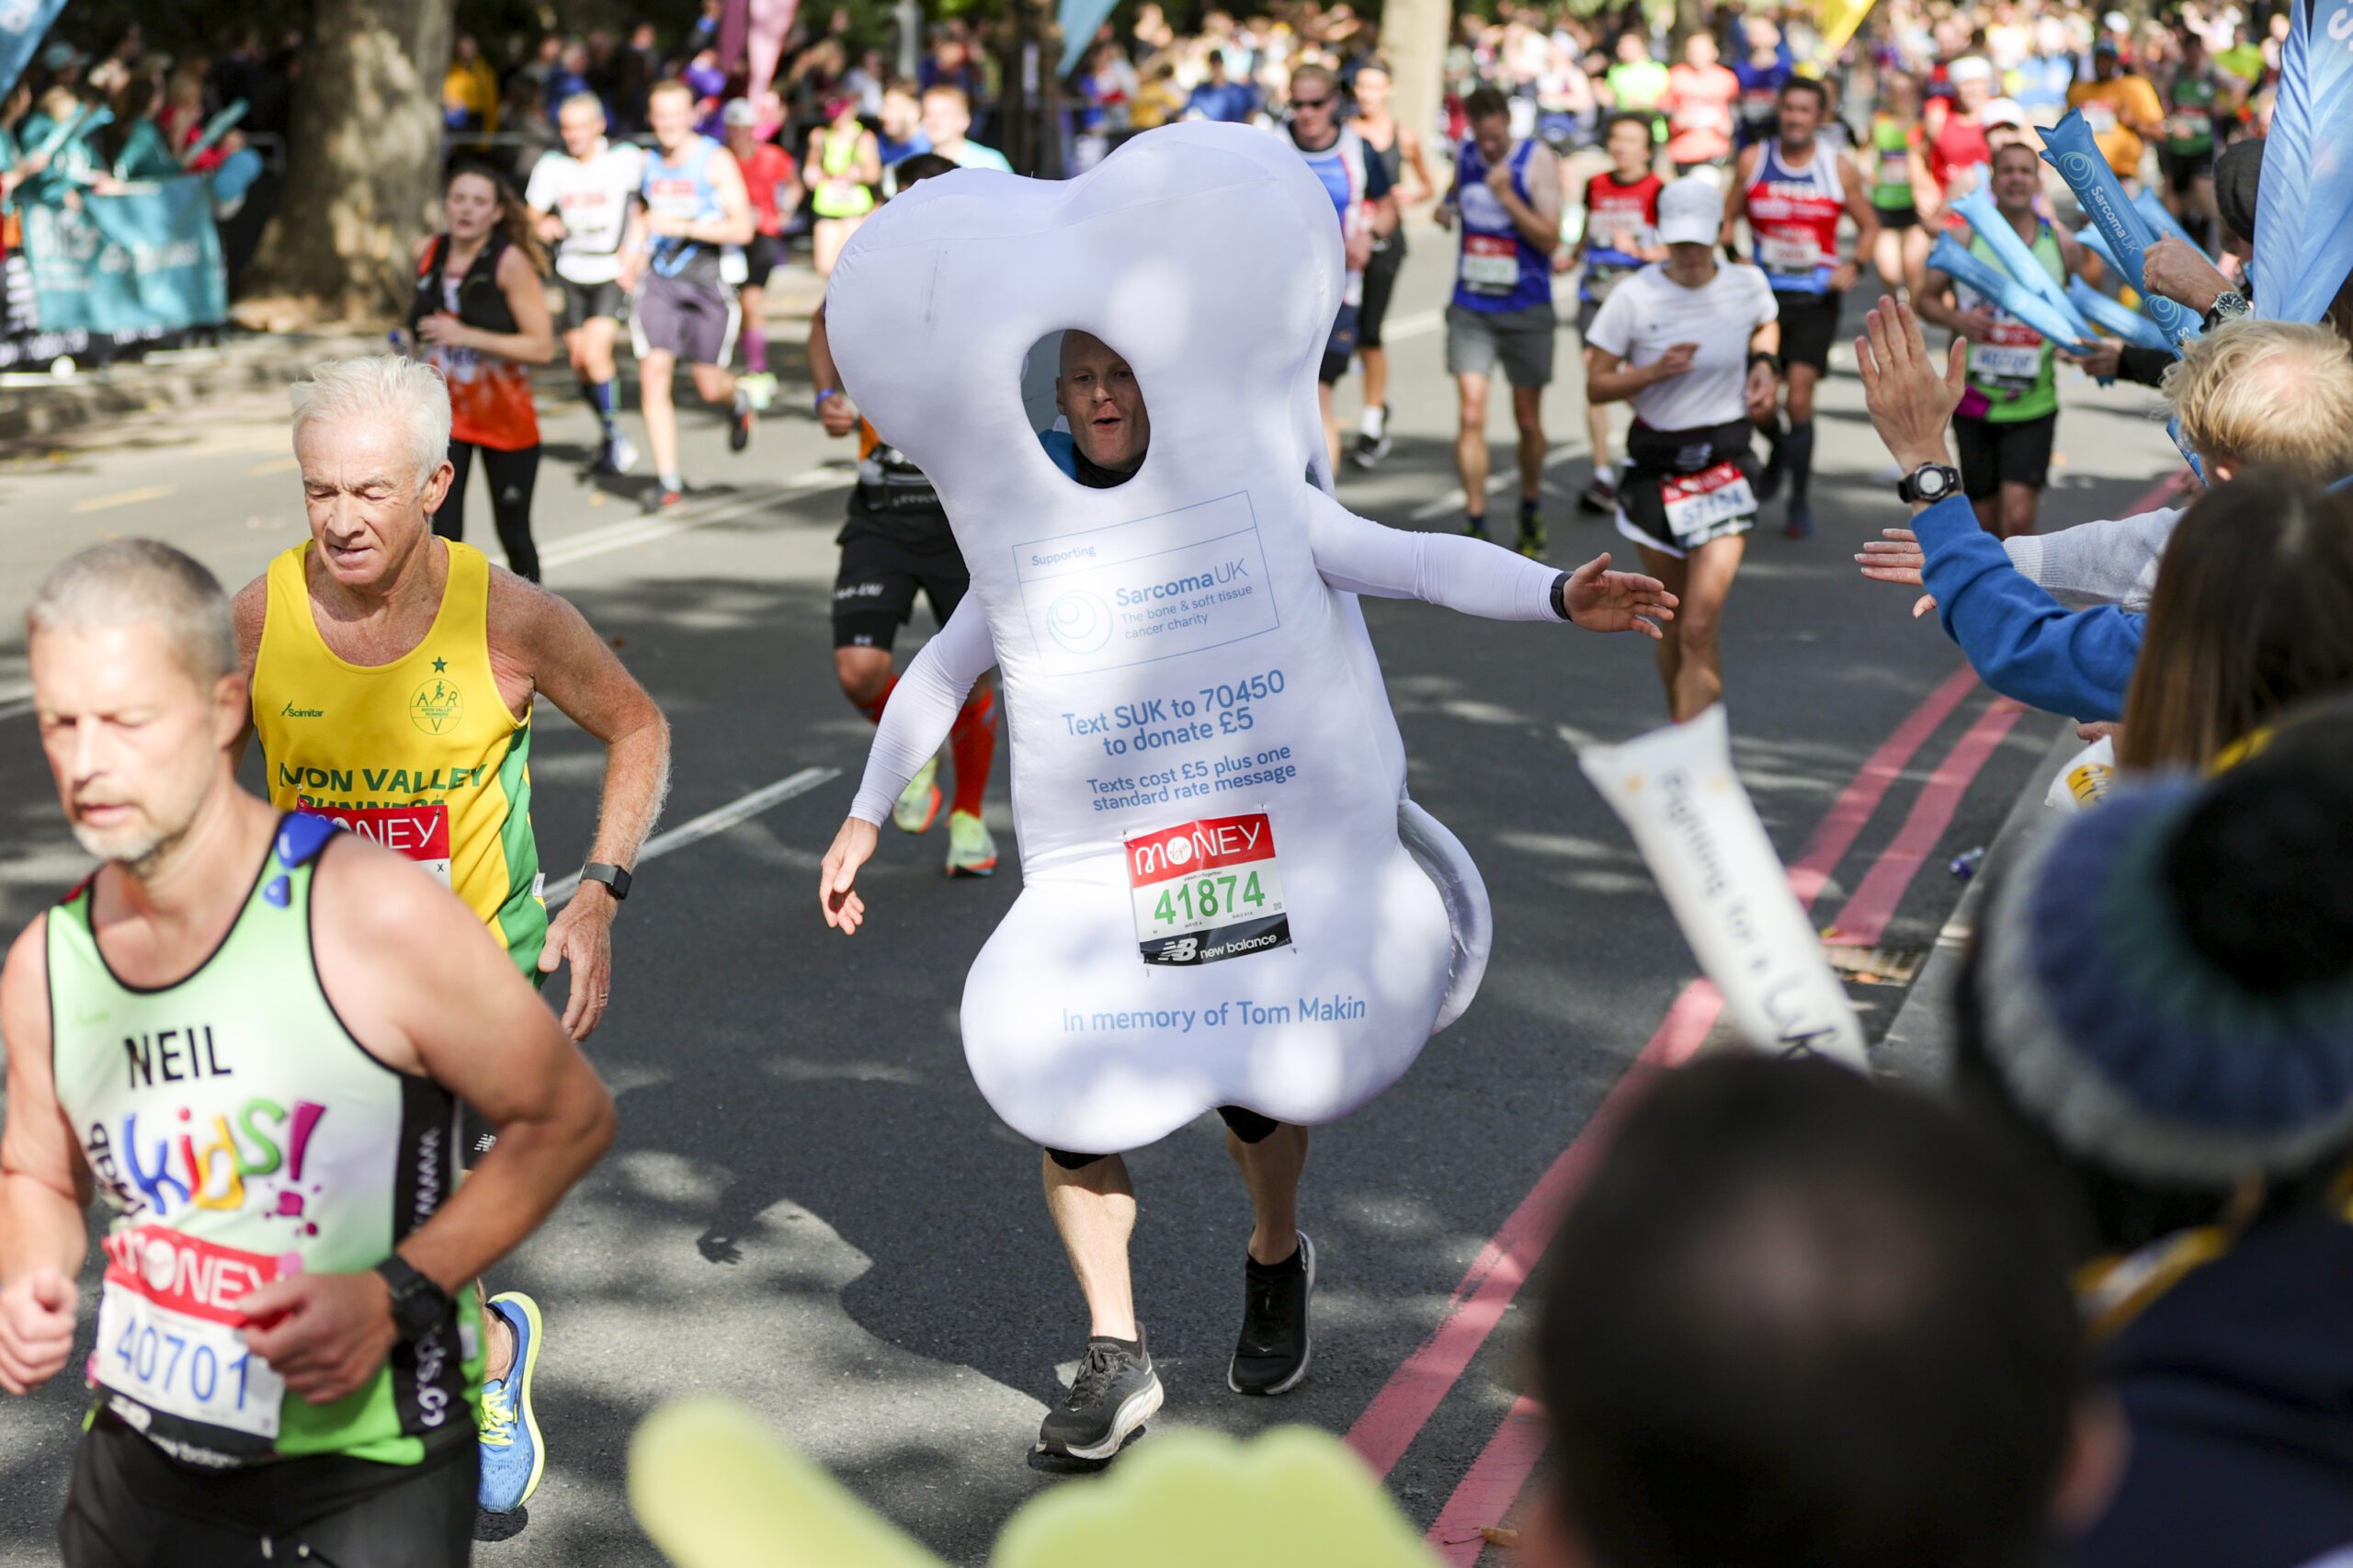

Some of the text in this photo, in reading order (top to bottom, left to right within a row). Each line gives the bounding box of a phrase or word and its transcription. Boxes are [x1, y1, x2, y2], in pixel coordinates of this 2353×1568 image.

[2090, 185, 2128, 239] Sarcoma
[2121, 233, 2142, 256] UK
[1031, 545, 1096, 566] Supporting
[1116, 558, 1249, 607] Sarcoma UK
[1120, 584, 1253, 625] The bone & soft tissue
[1124, 612, 1209, 641] cancer charity
[288, 708, 324, 718] Scimitar
[1062, 669, 1286, 737] Text SUK to 70450
[1103, 707, 1254, 756] to donate £5
[279, 763, 353, 792] VON
[362, 764, 488, 793] VALLEY
[1086, 746, 1291, 795] Texts cost £5 plus one
[1093, 765, 1297, 811] standard rate message
[438, 863, 444, 872] X
[1135, 822, 1260, 876] MONEY
[1154, 870, 1266, 925] 41874
[1199, 945, 1225, 960] new
[1227, 934, 1278, 952] balance
[1063, 994, 1366, 1033] In memory of Tom Makin
[124, 1025, 233, 1090] NEIL
[116, 1315, 252, 1412] 40701
